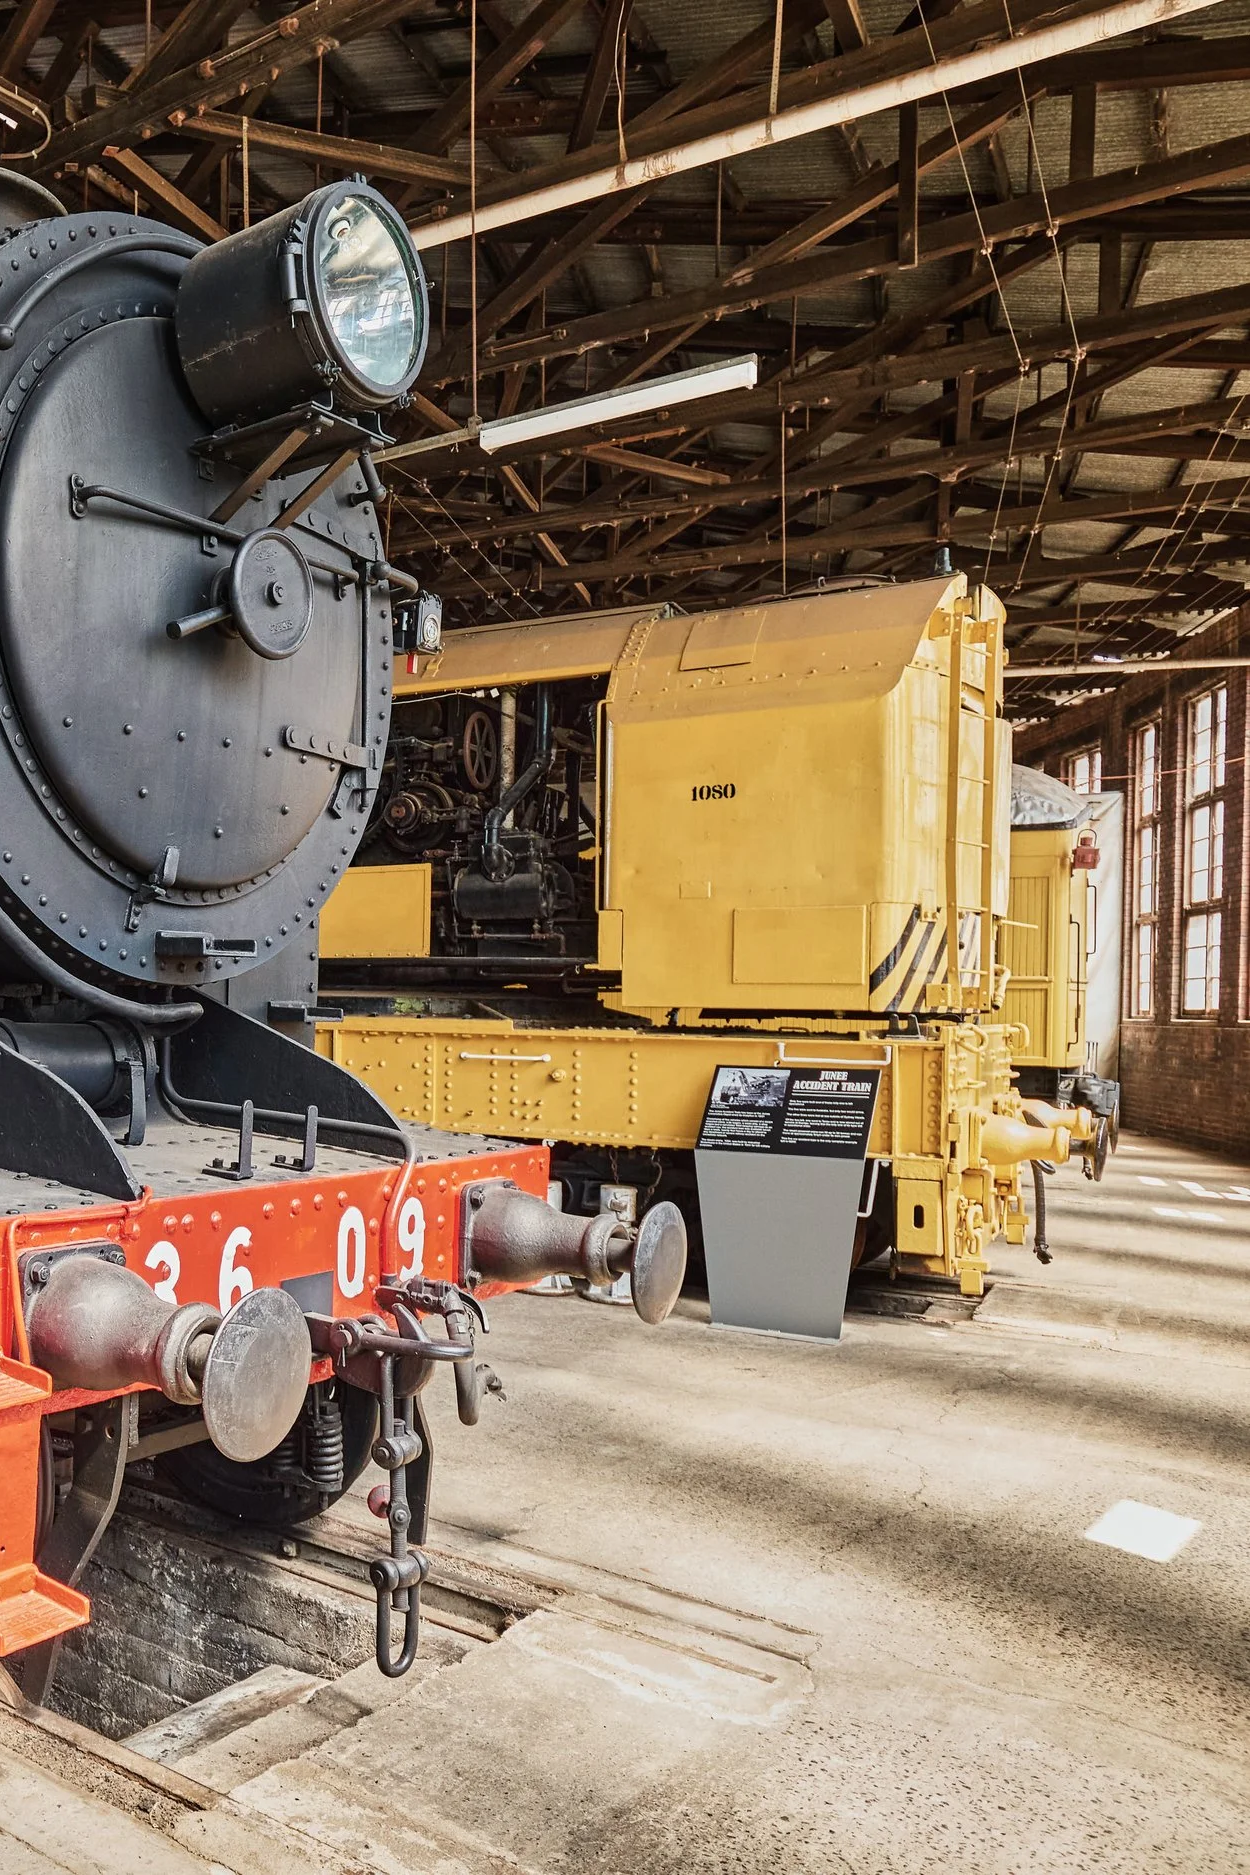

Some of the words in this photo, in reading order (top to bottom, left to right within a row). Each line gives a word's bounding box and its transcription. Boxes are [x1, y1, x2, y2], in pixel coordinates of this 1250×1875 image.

[691, 783, 736, 802] 1080
[820, 1071, 848, 1081] JUNEE
[793, 1081, 839, 1091] ACCIDENT
[841, 1082, 872, 1092] TRAIN
[144, 1196, 426, 1317] 3609
